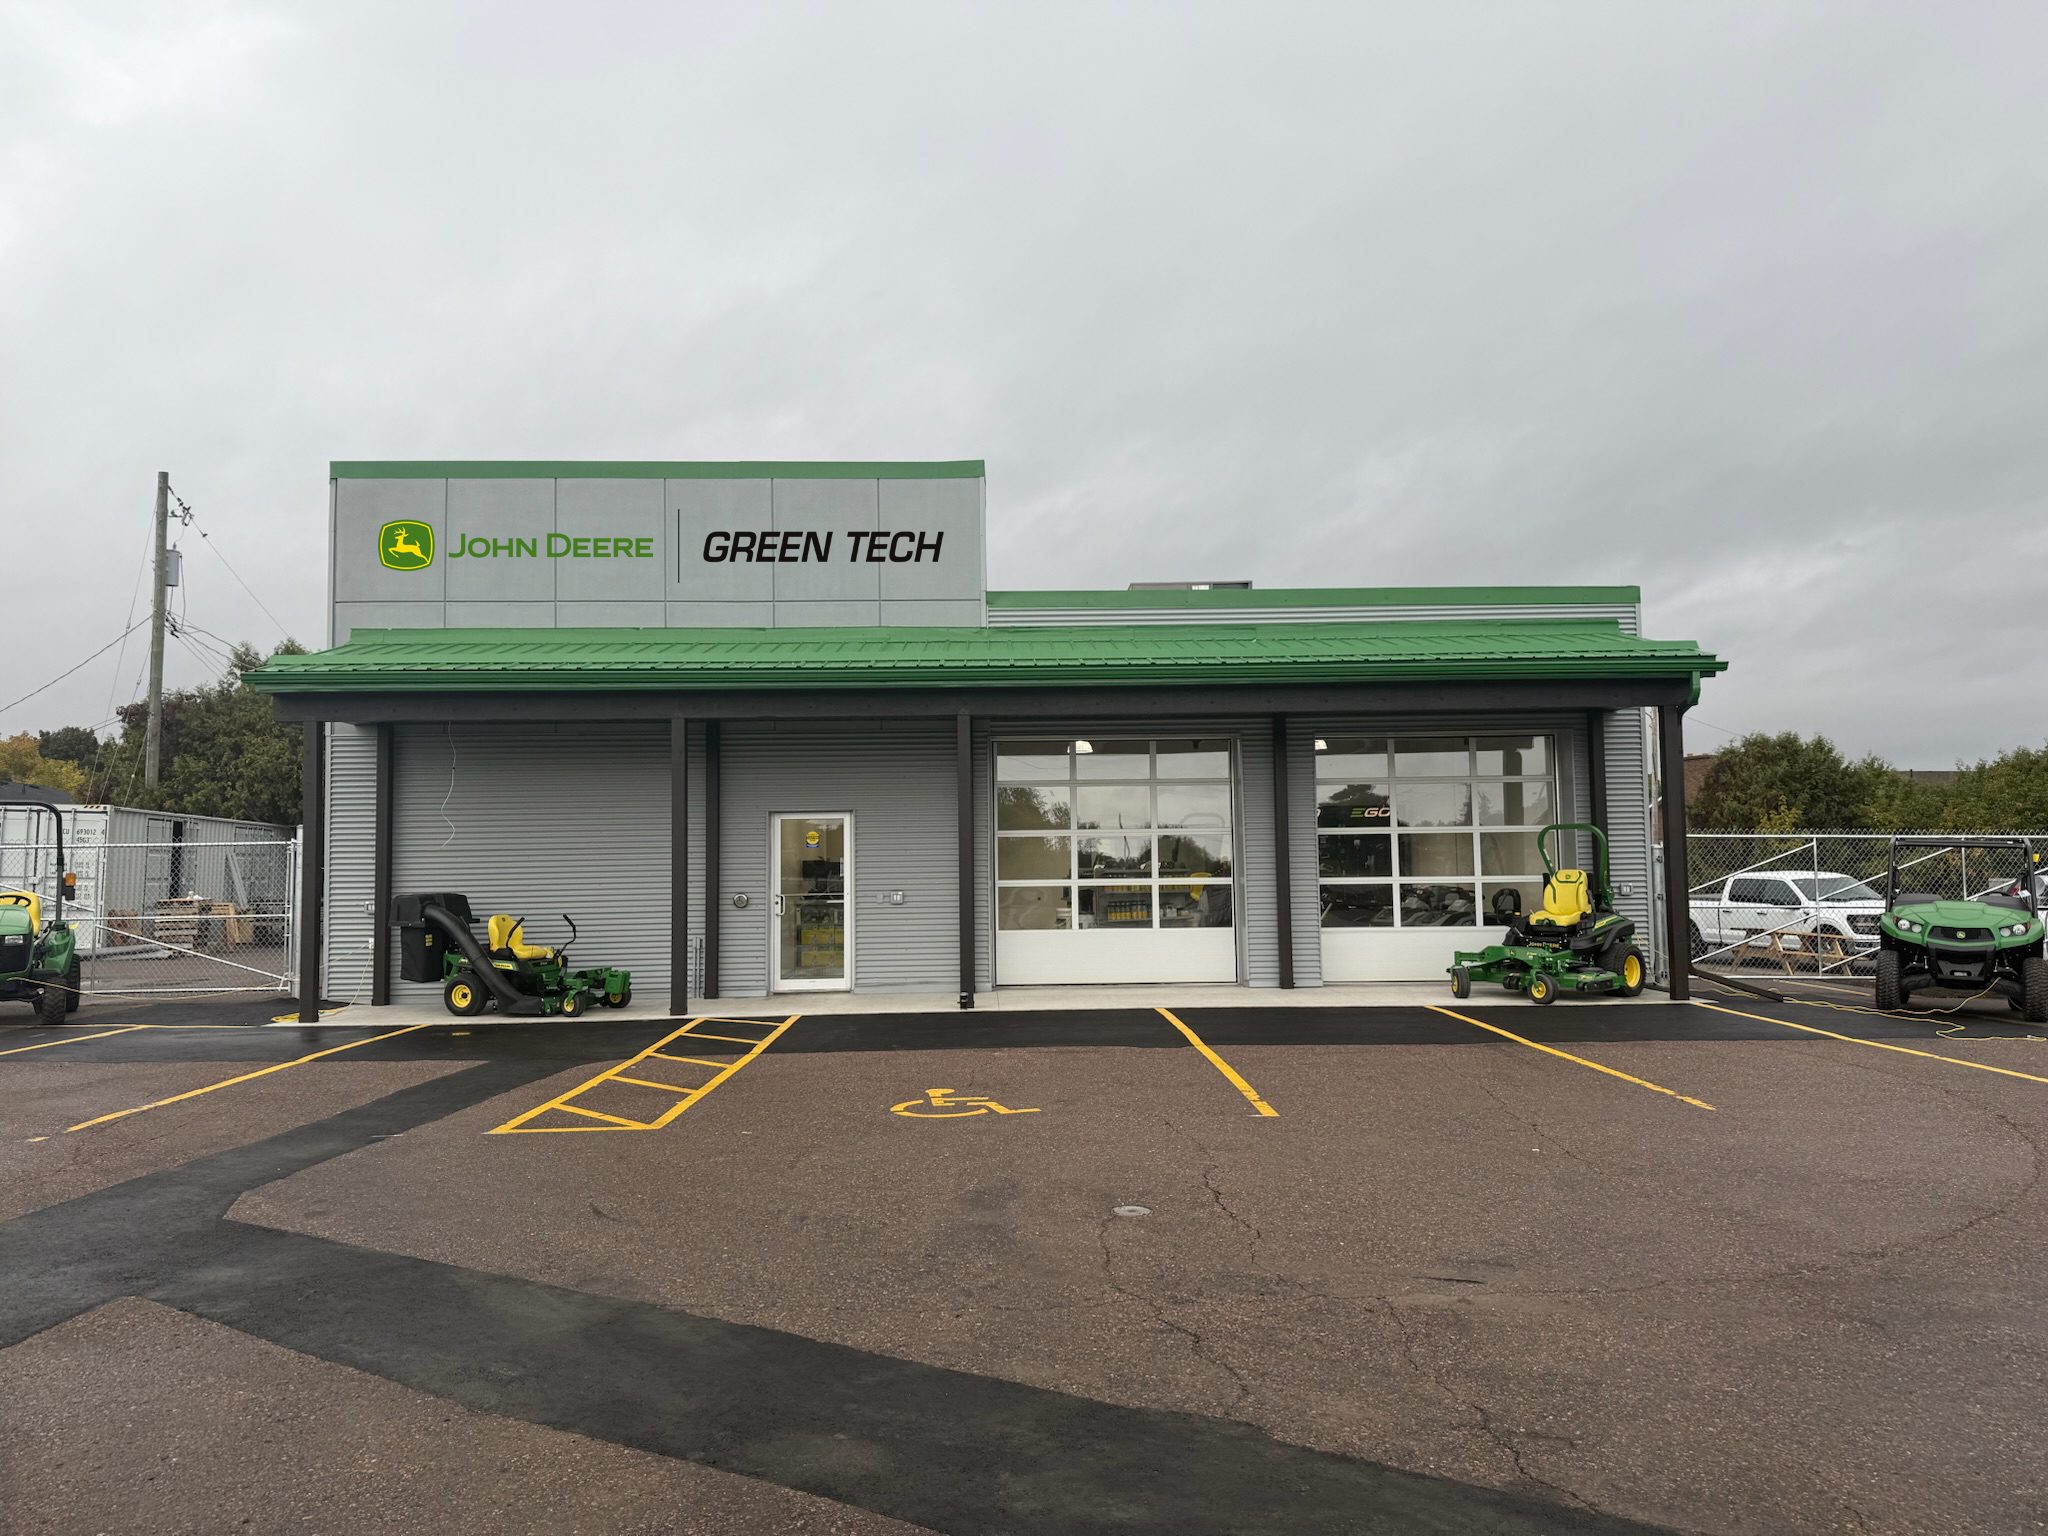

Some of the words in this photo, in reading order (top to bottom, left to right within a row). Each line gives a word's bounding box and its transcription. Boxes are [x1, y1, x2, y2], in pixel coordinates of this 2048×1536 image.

[448, 533, 537, 558] JOHN
[546, 533, 654, 558] DEERE
[703, 531, 833, 562] GREEN
[847, 531, 944, 562] TECH
[1350, 807, 1390, 818] EGO
